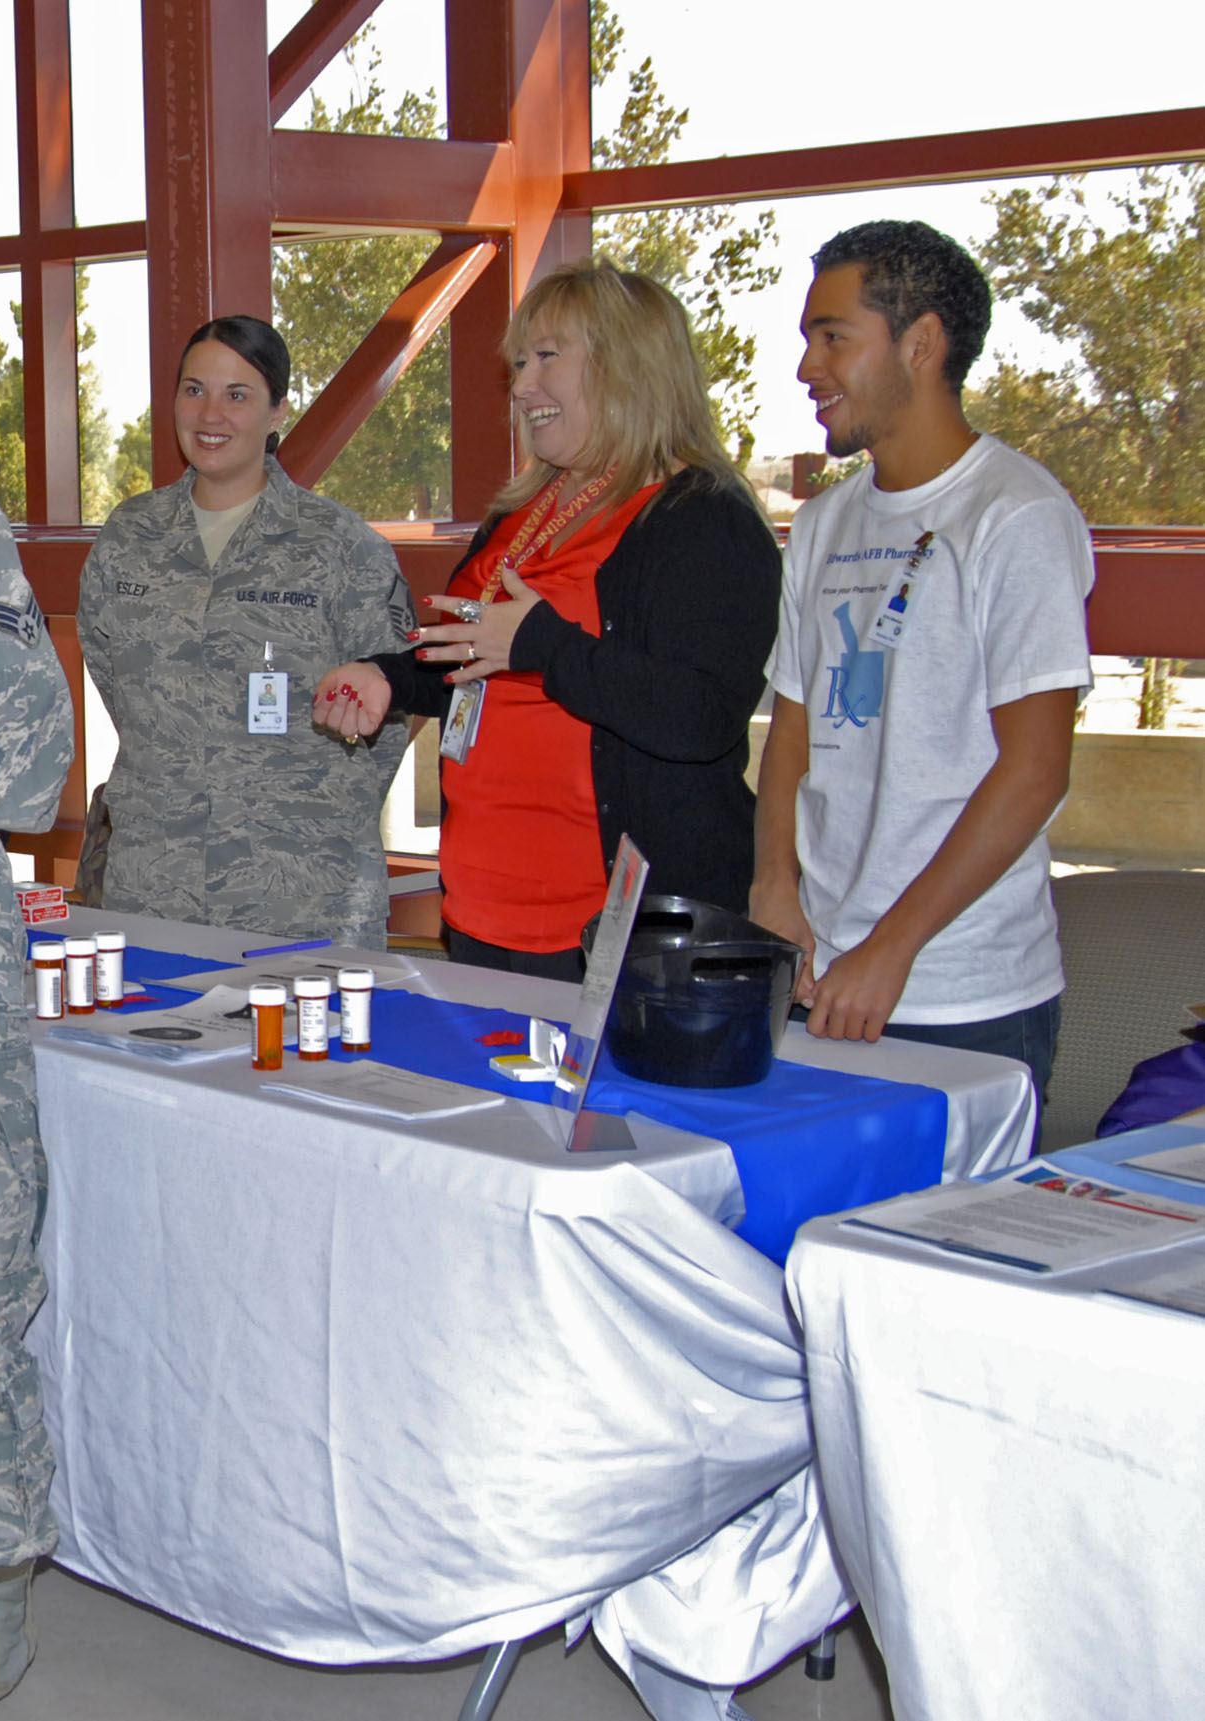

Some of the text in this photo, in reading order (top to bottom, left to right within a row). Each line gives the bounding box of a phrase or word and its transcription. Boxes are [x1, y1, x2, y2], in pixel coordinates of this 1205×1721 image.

[534, 494, 591, 549] MARINE
[863, 547, 883, 560] AFB
[884, 546, 934, 560] Pharmcy
[236, 591, 318, 608] U.S. AIR FORCE
